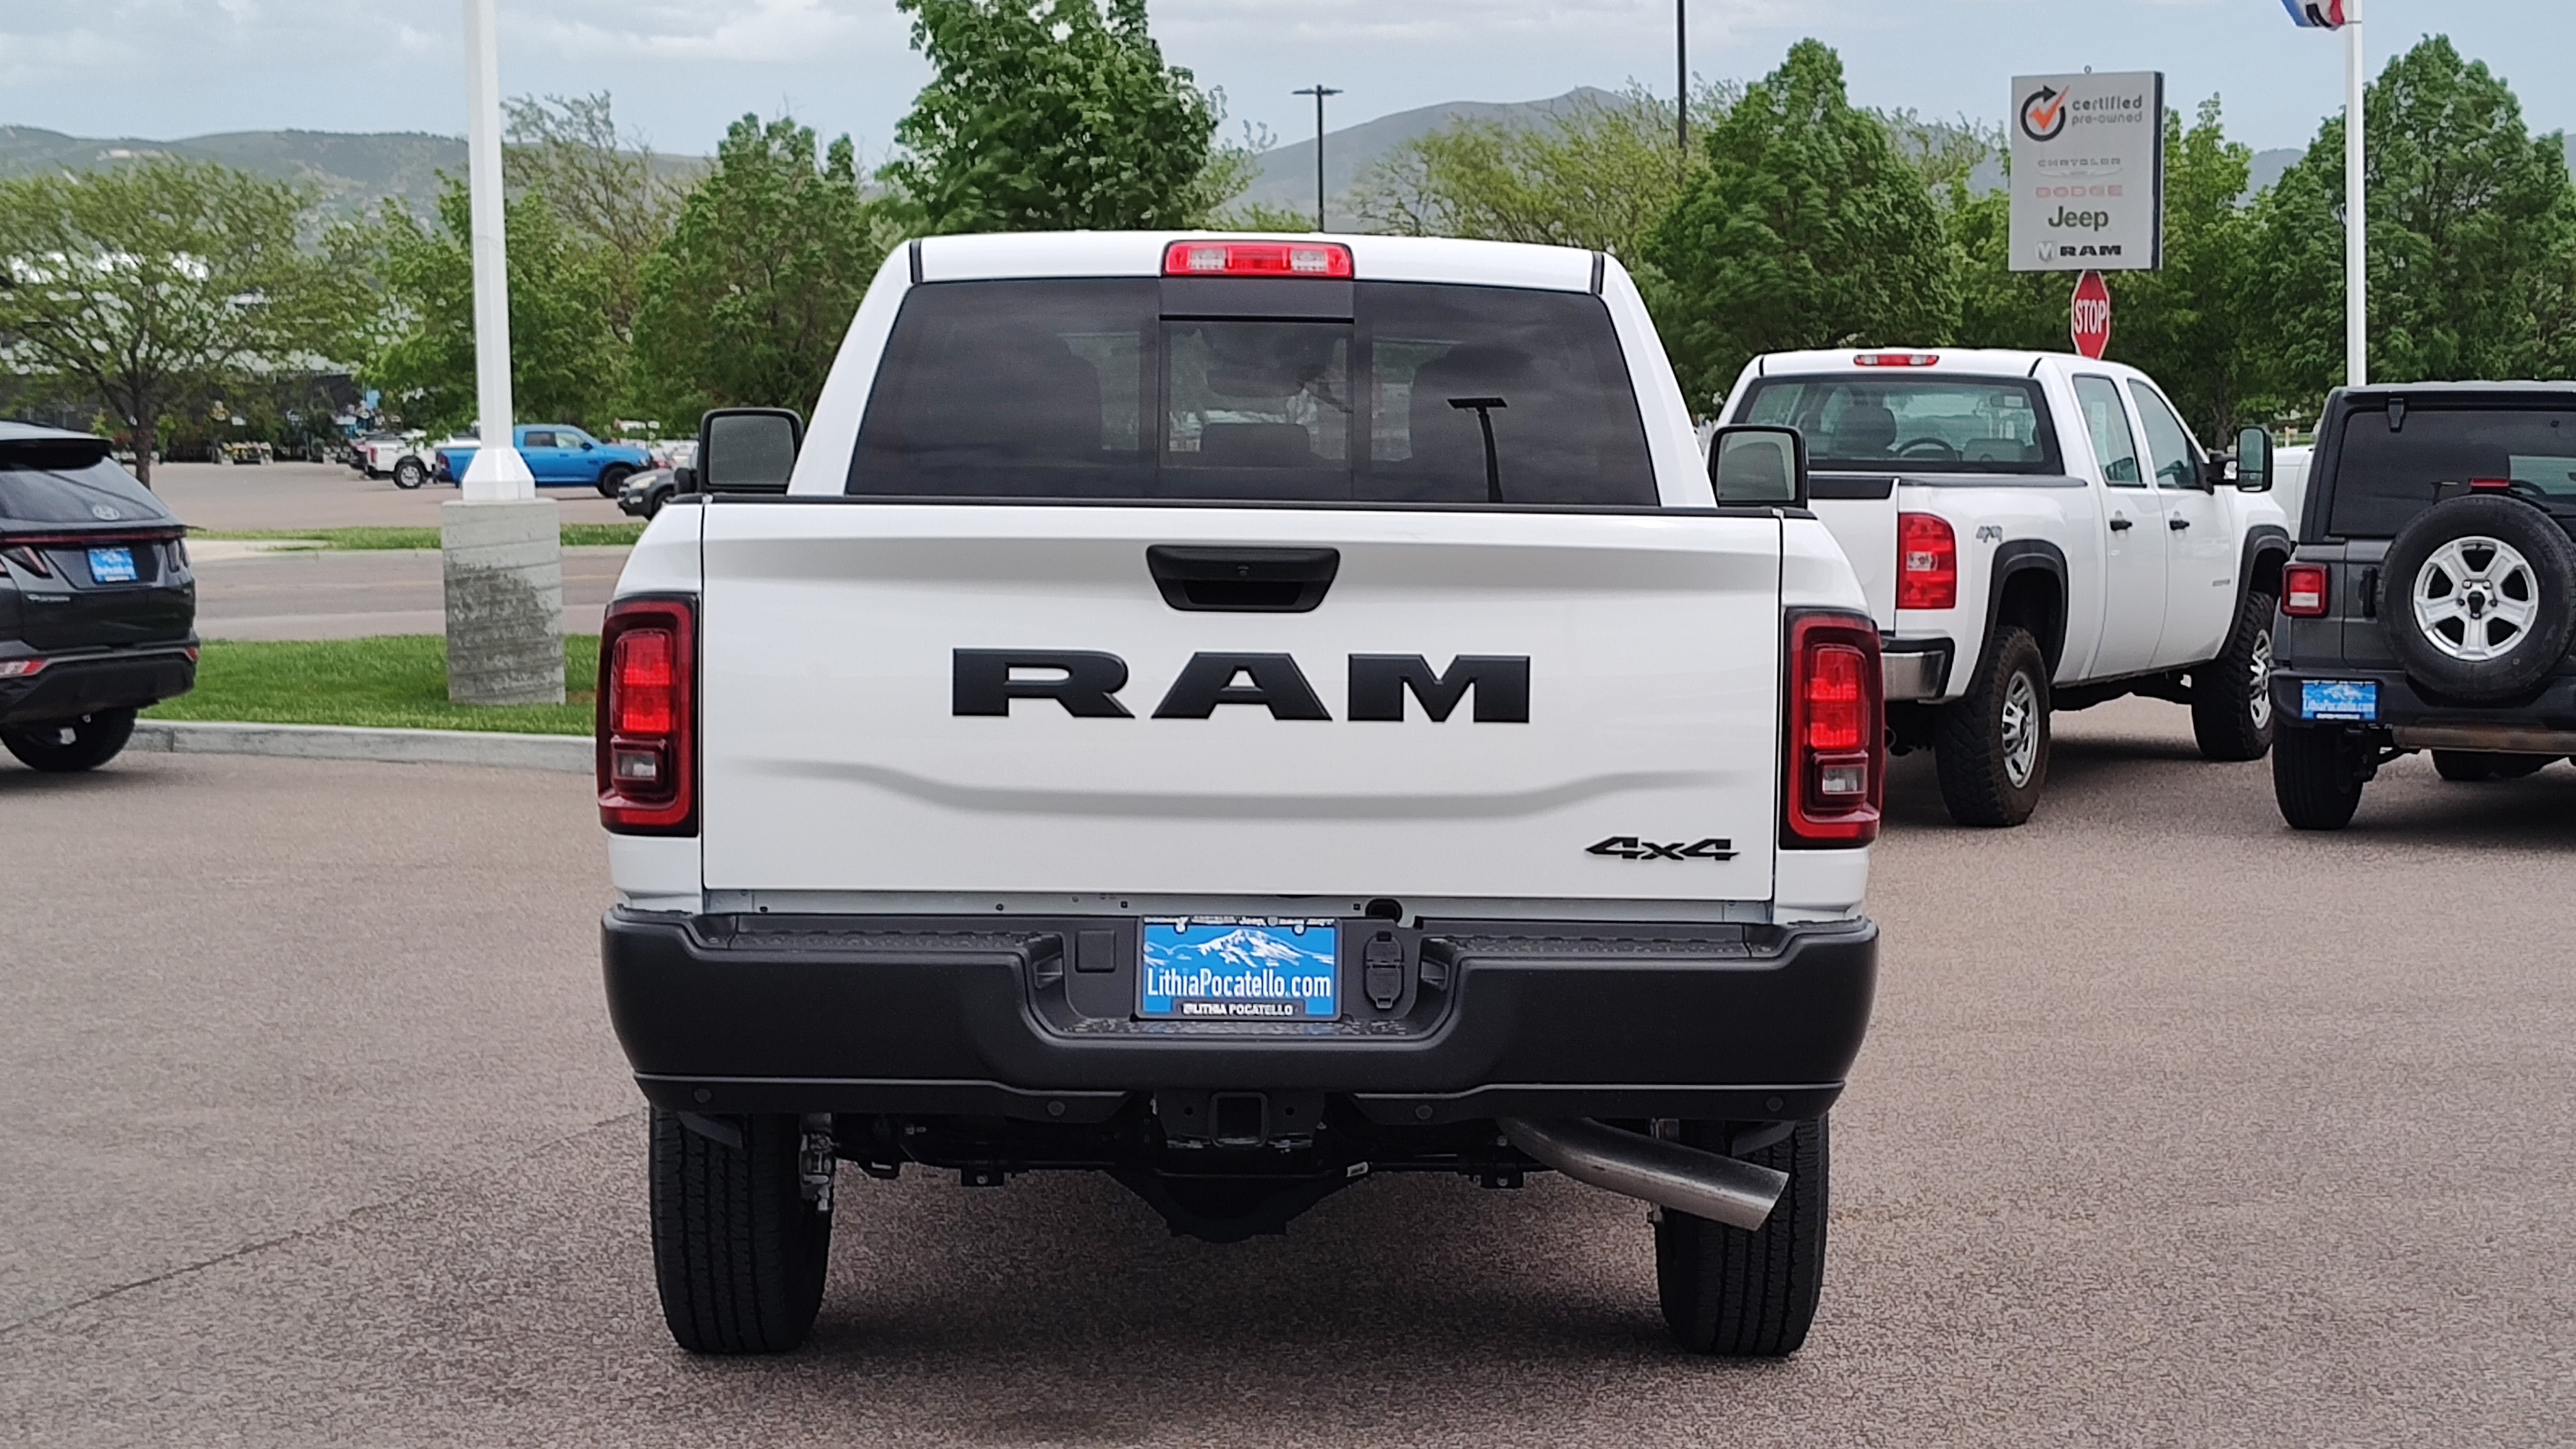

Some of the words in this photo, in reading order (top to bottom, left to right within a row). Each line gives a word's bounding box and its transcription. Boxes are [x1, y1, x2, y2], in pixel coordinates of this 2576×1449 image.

[2072, 94, 2142, 111] certified
[2072, 111, 2142, 126] pre-owned
[2038, 158, 2121, 167] CHRYSLER
[2036, 185, 2123, 198] DODGE
[2048, 206, 2109, 232] Jeep
[2060, 245, 2121, 256] RAM
[2075, 299, 2106, 334] STOP
[952, 647, 1531, 723] RAM
[1147, 968, 1331, 997] LithiaPocatello.com
[1194, 1003, 1227, 1015] LITHIA
[1228, 1004, 1294, 1016] POCATELLO
